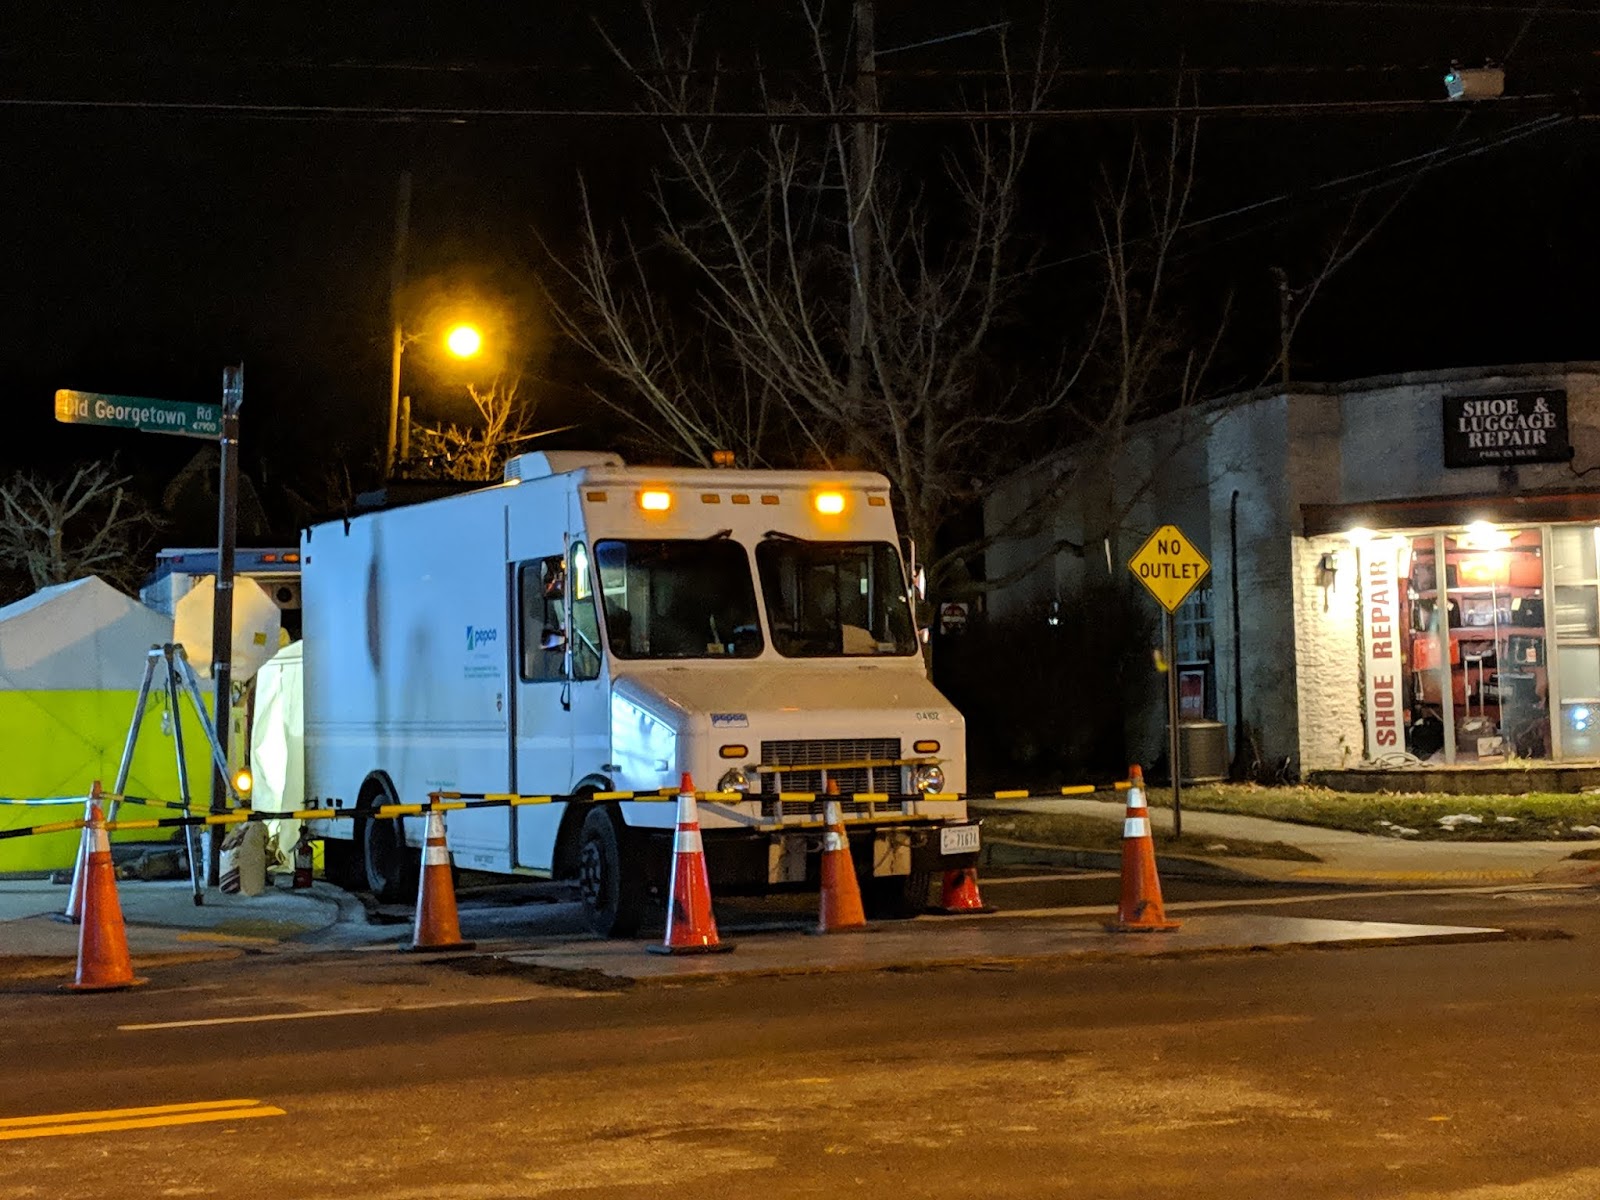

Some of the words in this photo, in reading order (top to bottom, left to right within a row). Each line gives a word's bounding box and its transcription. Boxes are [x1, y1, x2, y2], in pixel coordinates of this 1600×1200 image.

[64, 398, 88, 417] Old
[95, 400, 186, 427] Georgetown
[197, 405, 212, 420] Rd
[1462, 399, 1518, 417] SHOE
[1534, 397, 1549, 413] &
[1459, 413, 1556, 432] LUGGAGE
[1468, 429, 1547, 448] REPAIR
[1158, 539, 1181, 555] NO
[1140, 563, 1200, 578] OUTLET
[1370, 561, 1393, 659] REPAIR
[475, 629, 497, 647] pepco
[712, 713, 747, 724] pepco
[1374, 675, 1397, 746] SHOE
